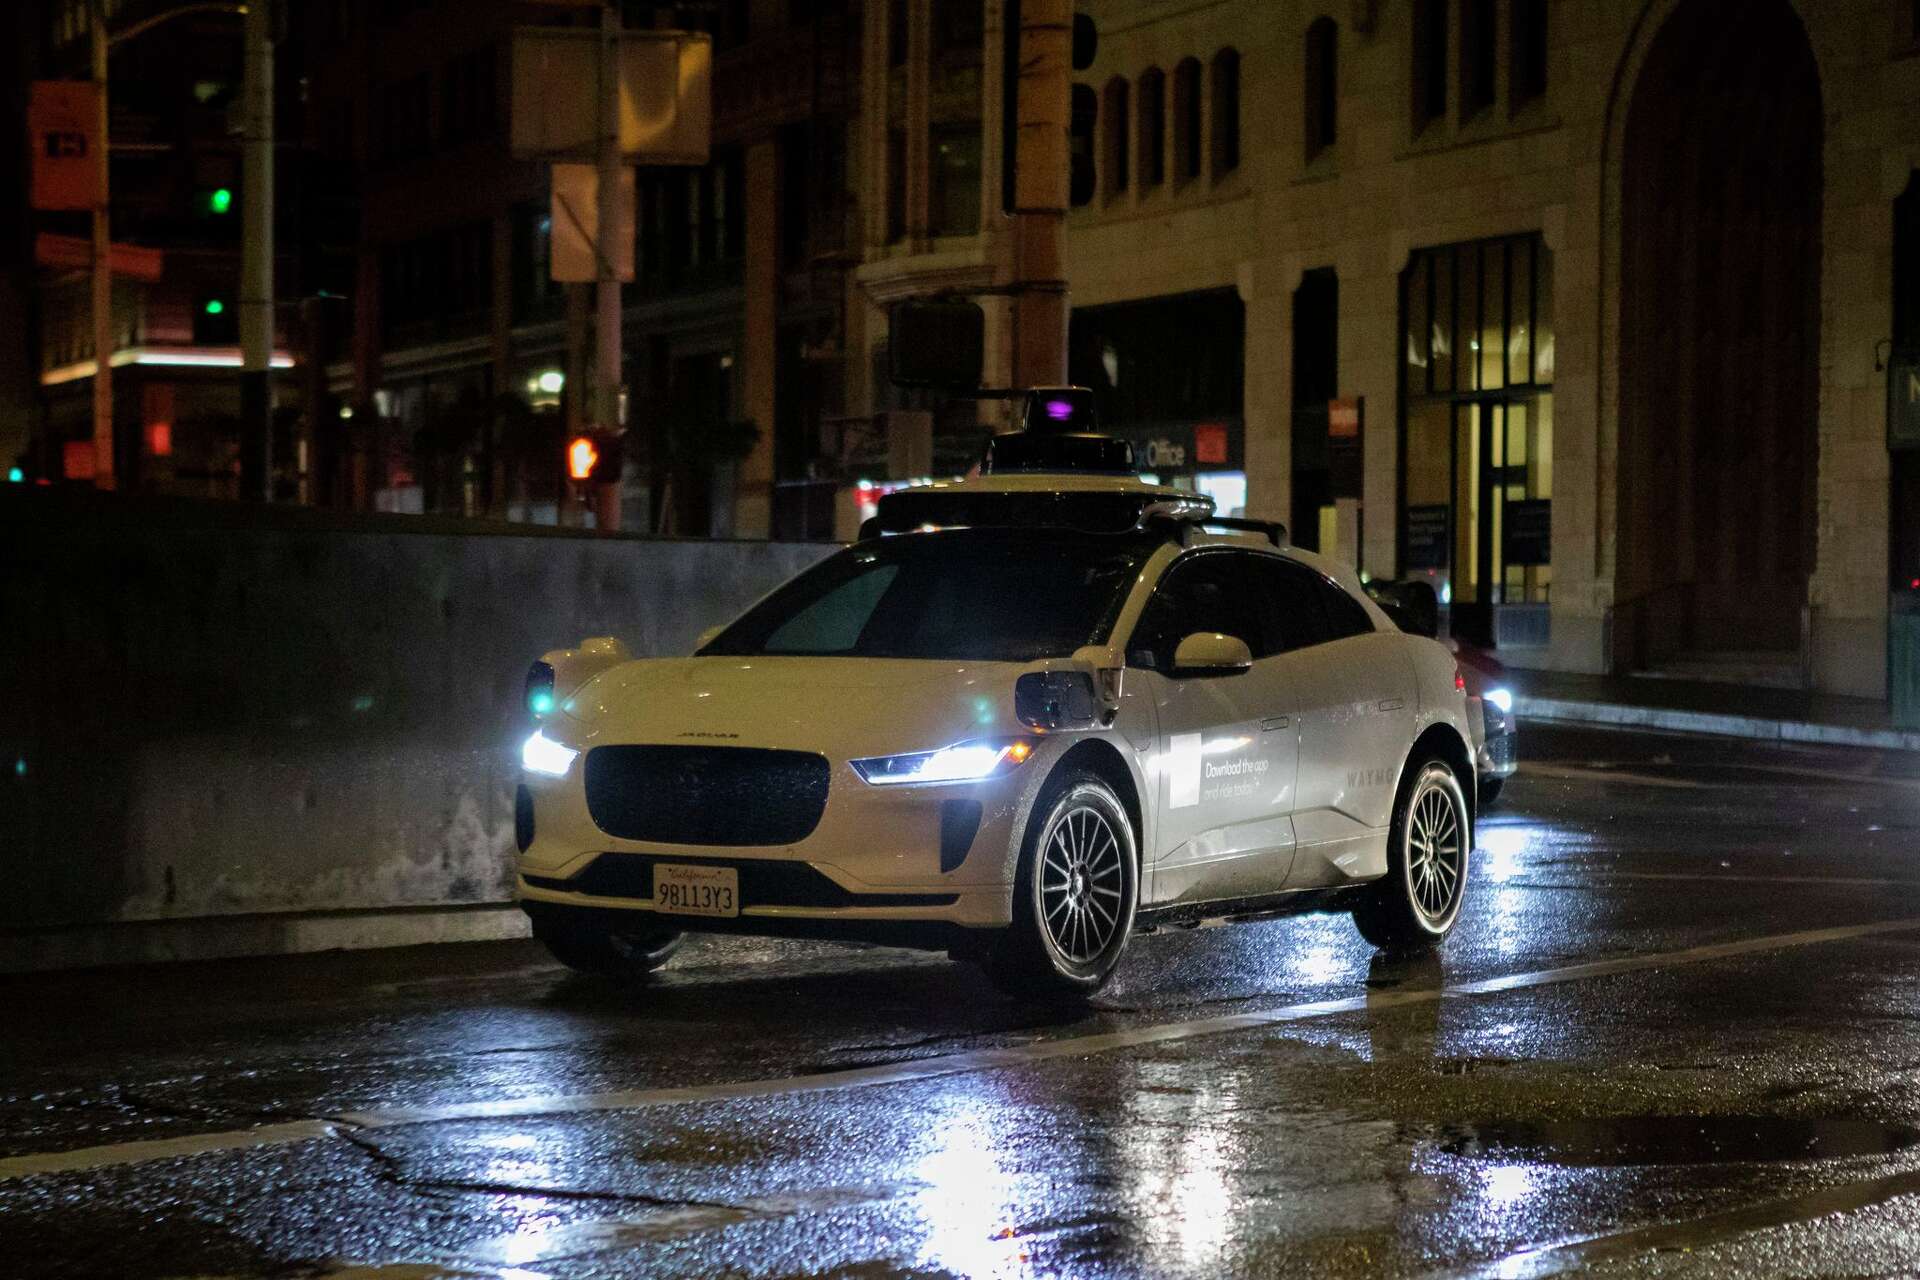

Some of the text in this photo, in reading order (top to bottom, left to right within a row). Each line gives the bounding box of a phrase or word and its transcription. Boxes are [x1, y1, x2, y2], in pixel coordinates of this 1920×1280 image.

[1205, 758, 1269, 778] Download the app
[659, 883, 733, 910] 98113Y3
